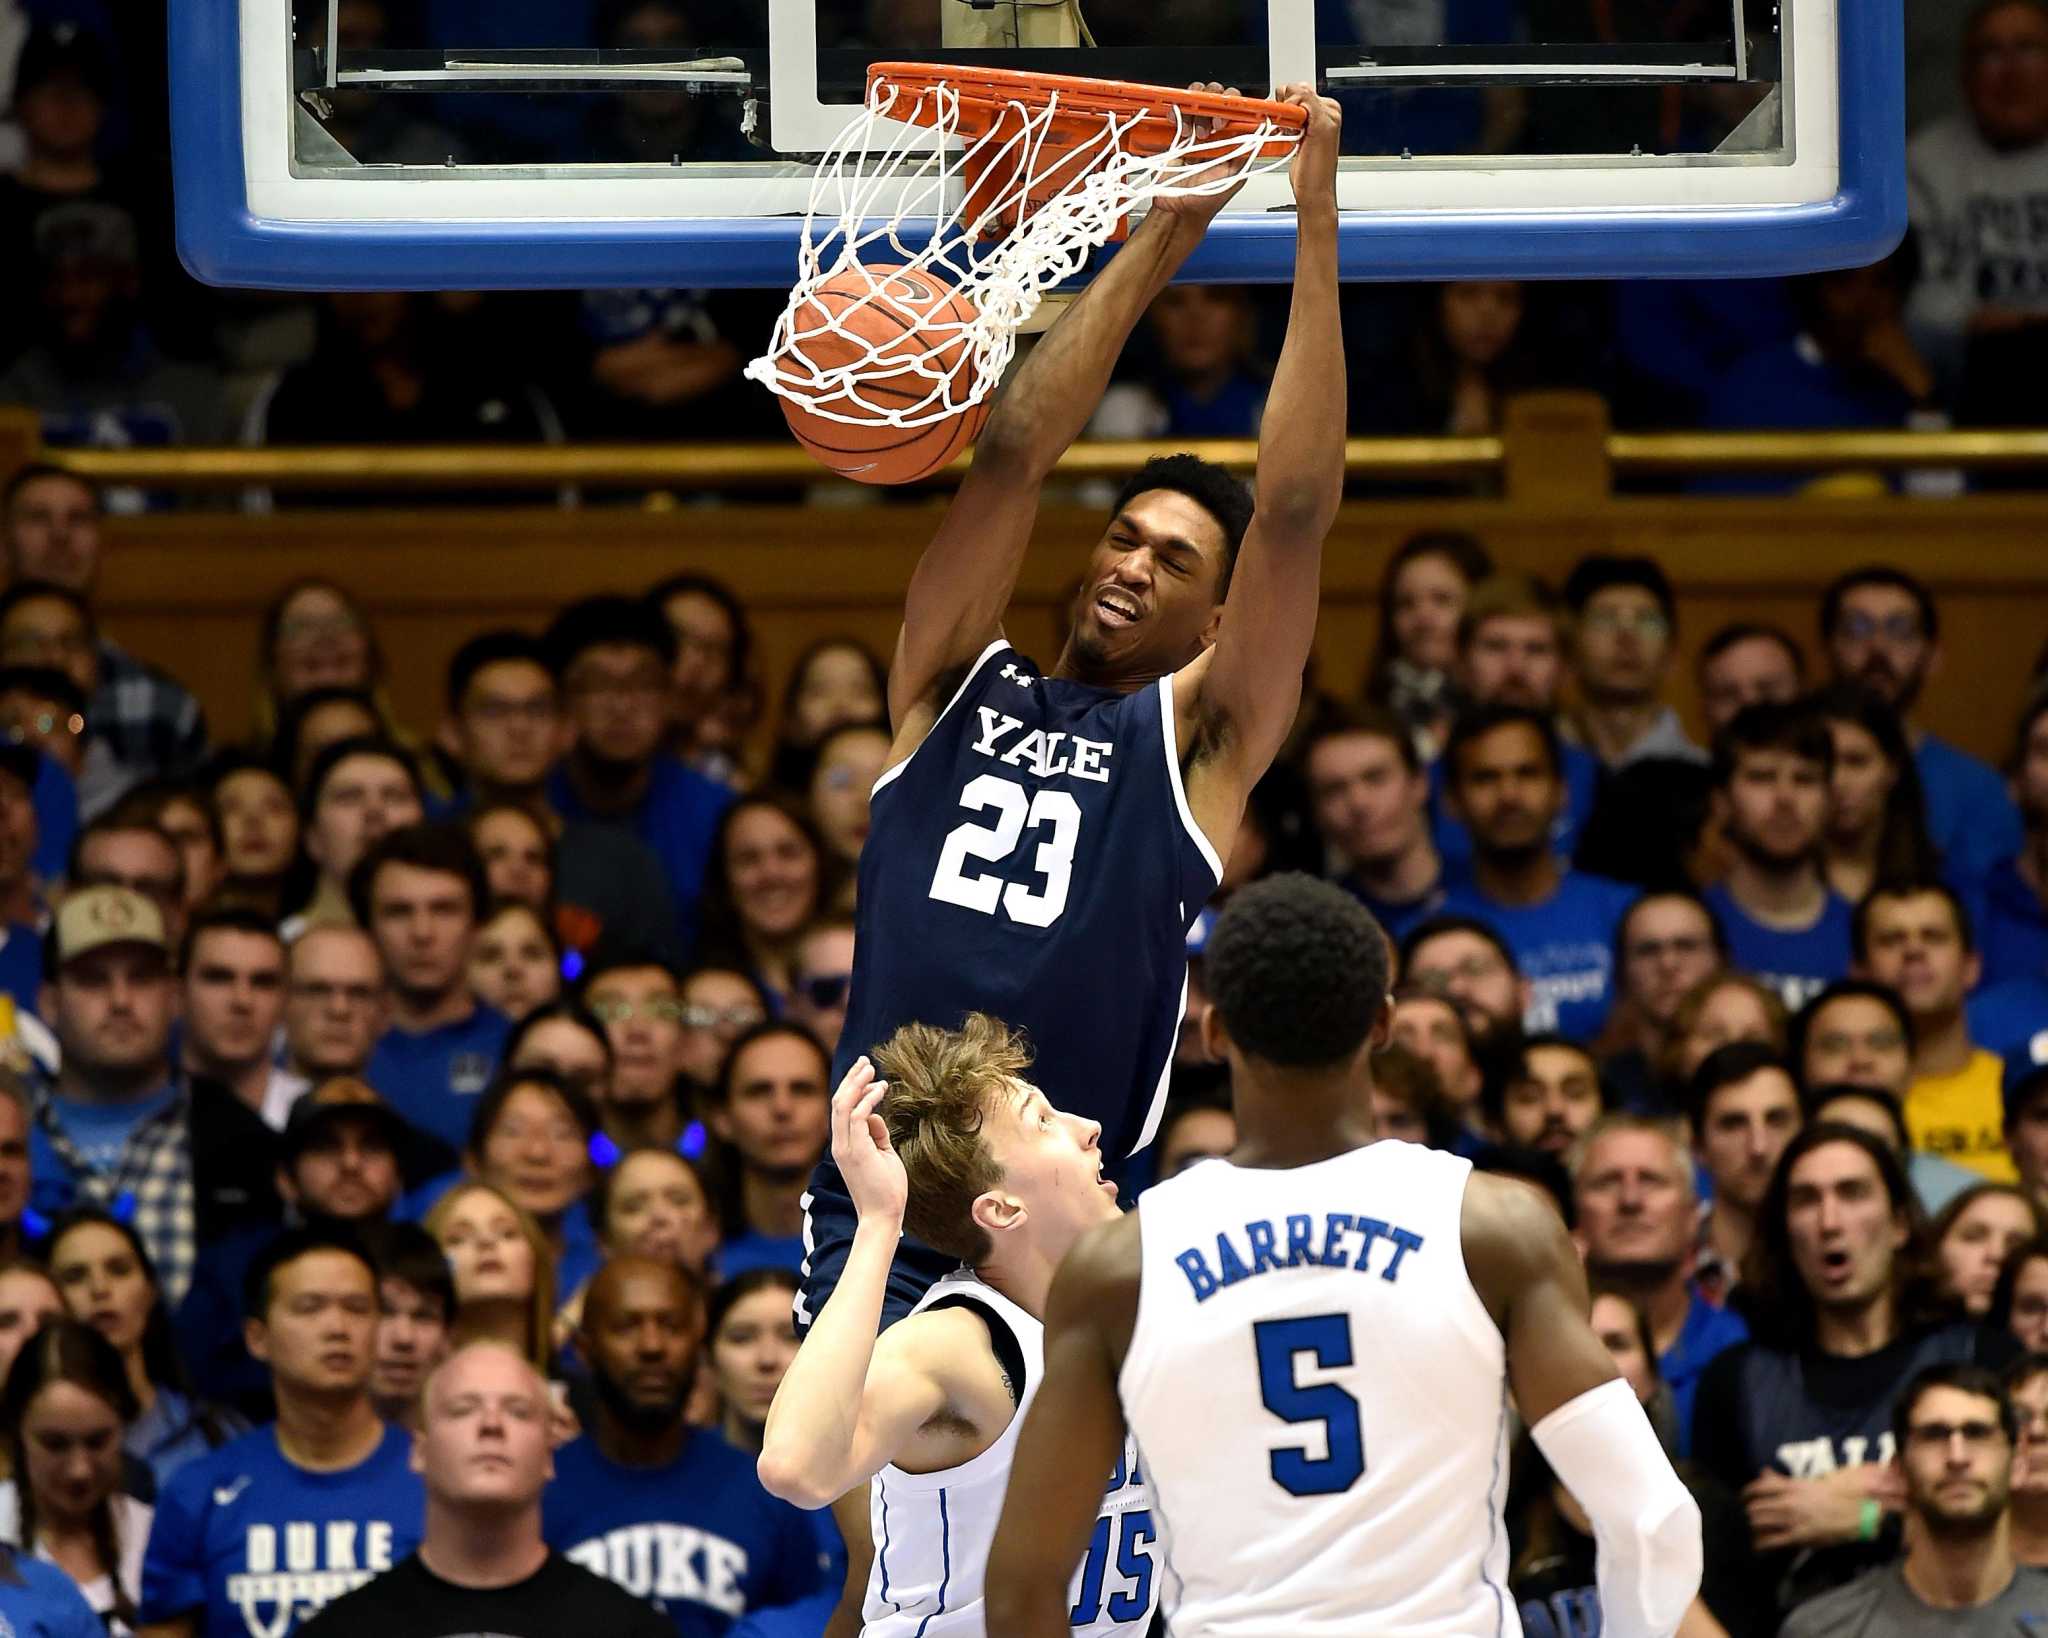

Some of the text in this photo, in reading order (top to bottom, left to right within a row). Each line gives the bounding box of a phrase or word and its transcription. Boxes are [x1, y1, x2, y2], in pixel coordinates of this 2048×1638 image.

[972, 706, 1113, 782] YALE
[929, 774, 1082, 928] 23
[1176, 1213, 1423, 1303] BARRETT
[1253, 1312, 1366, 1497] 5
[247, 1520, 393, 1573] DUKE
[1071, 1511, 1157, 1626] 15
